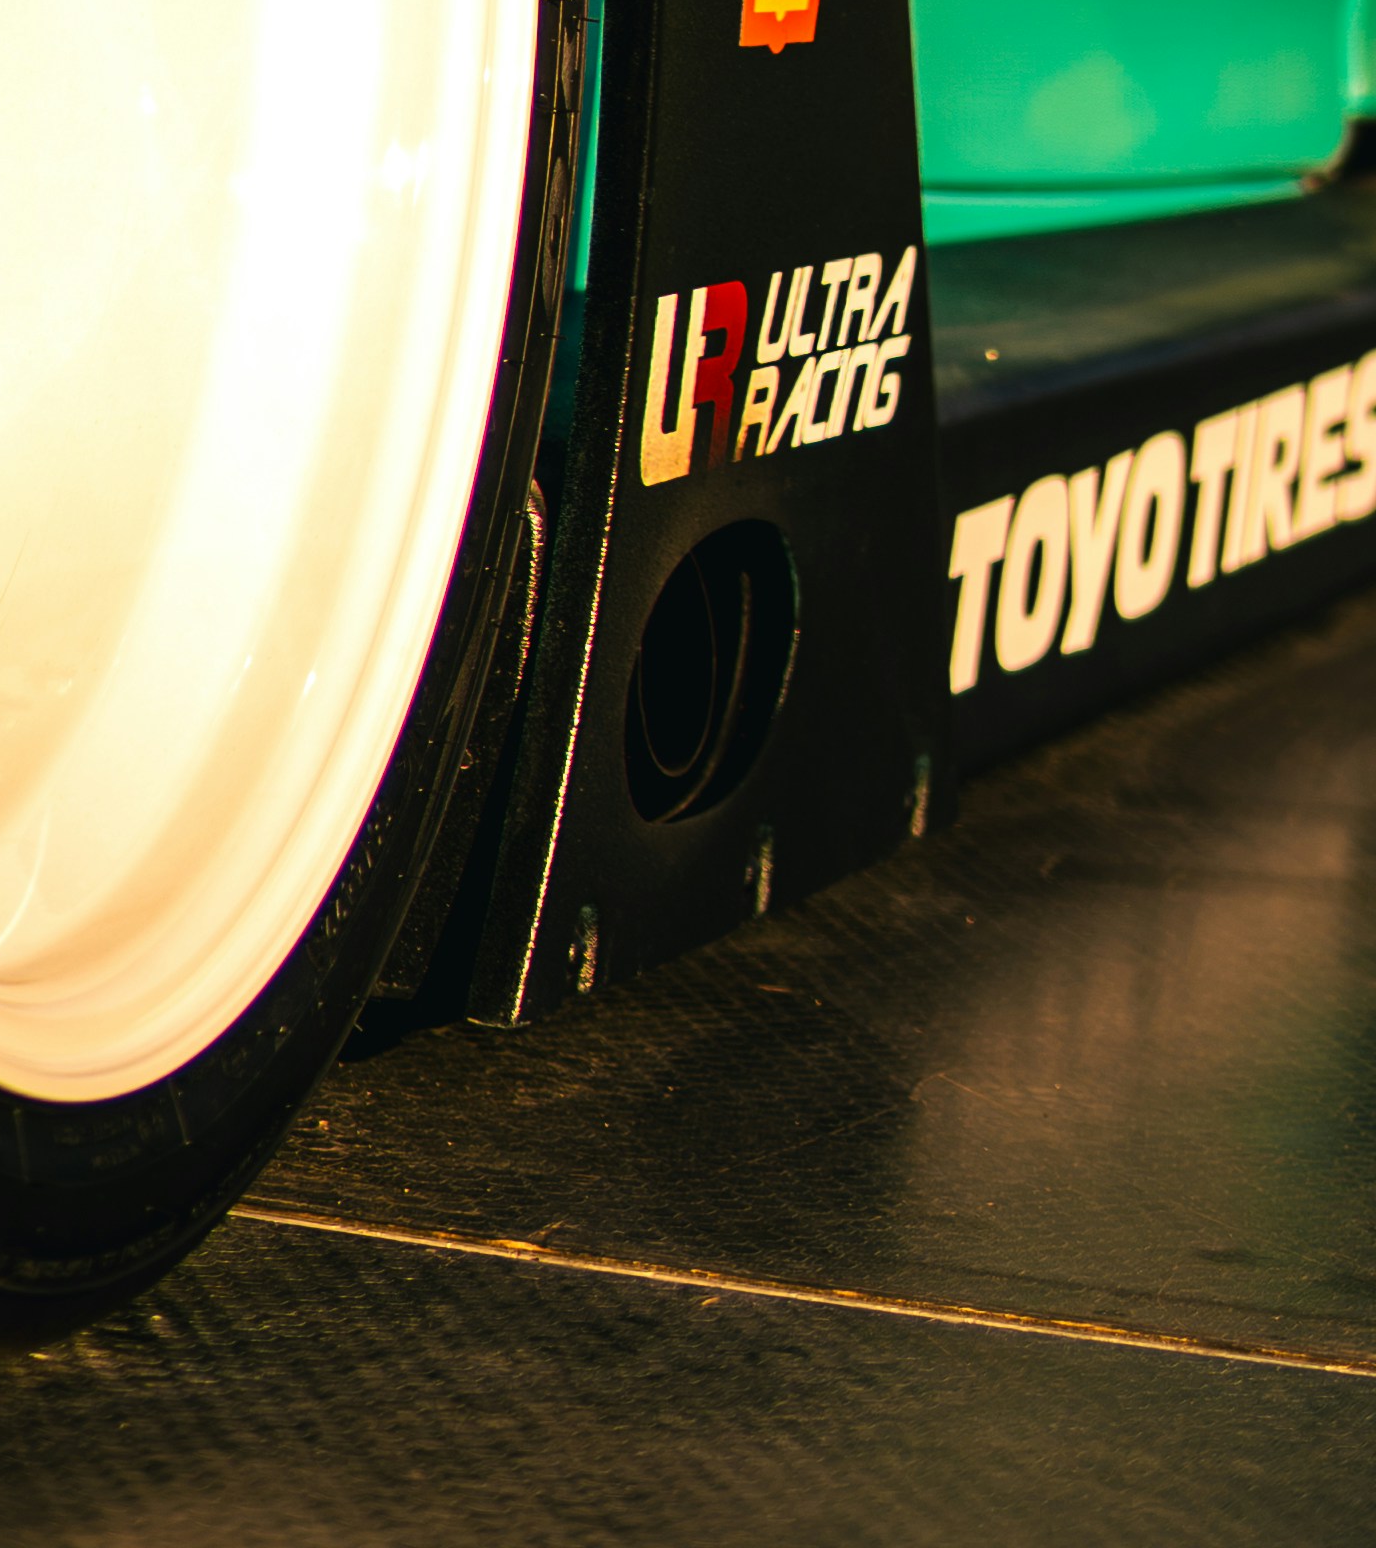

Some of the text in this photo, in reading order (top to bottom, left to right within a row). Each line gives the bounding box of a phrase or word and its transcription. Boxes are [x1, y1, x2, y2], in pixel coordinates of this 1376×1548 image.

[757, 245, 917, 364] ULTRA
[733, 334, 911, 463] RACING
[949, 431, 1186, 696] TOYO
